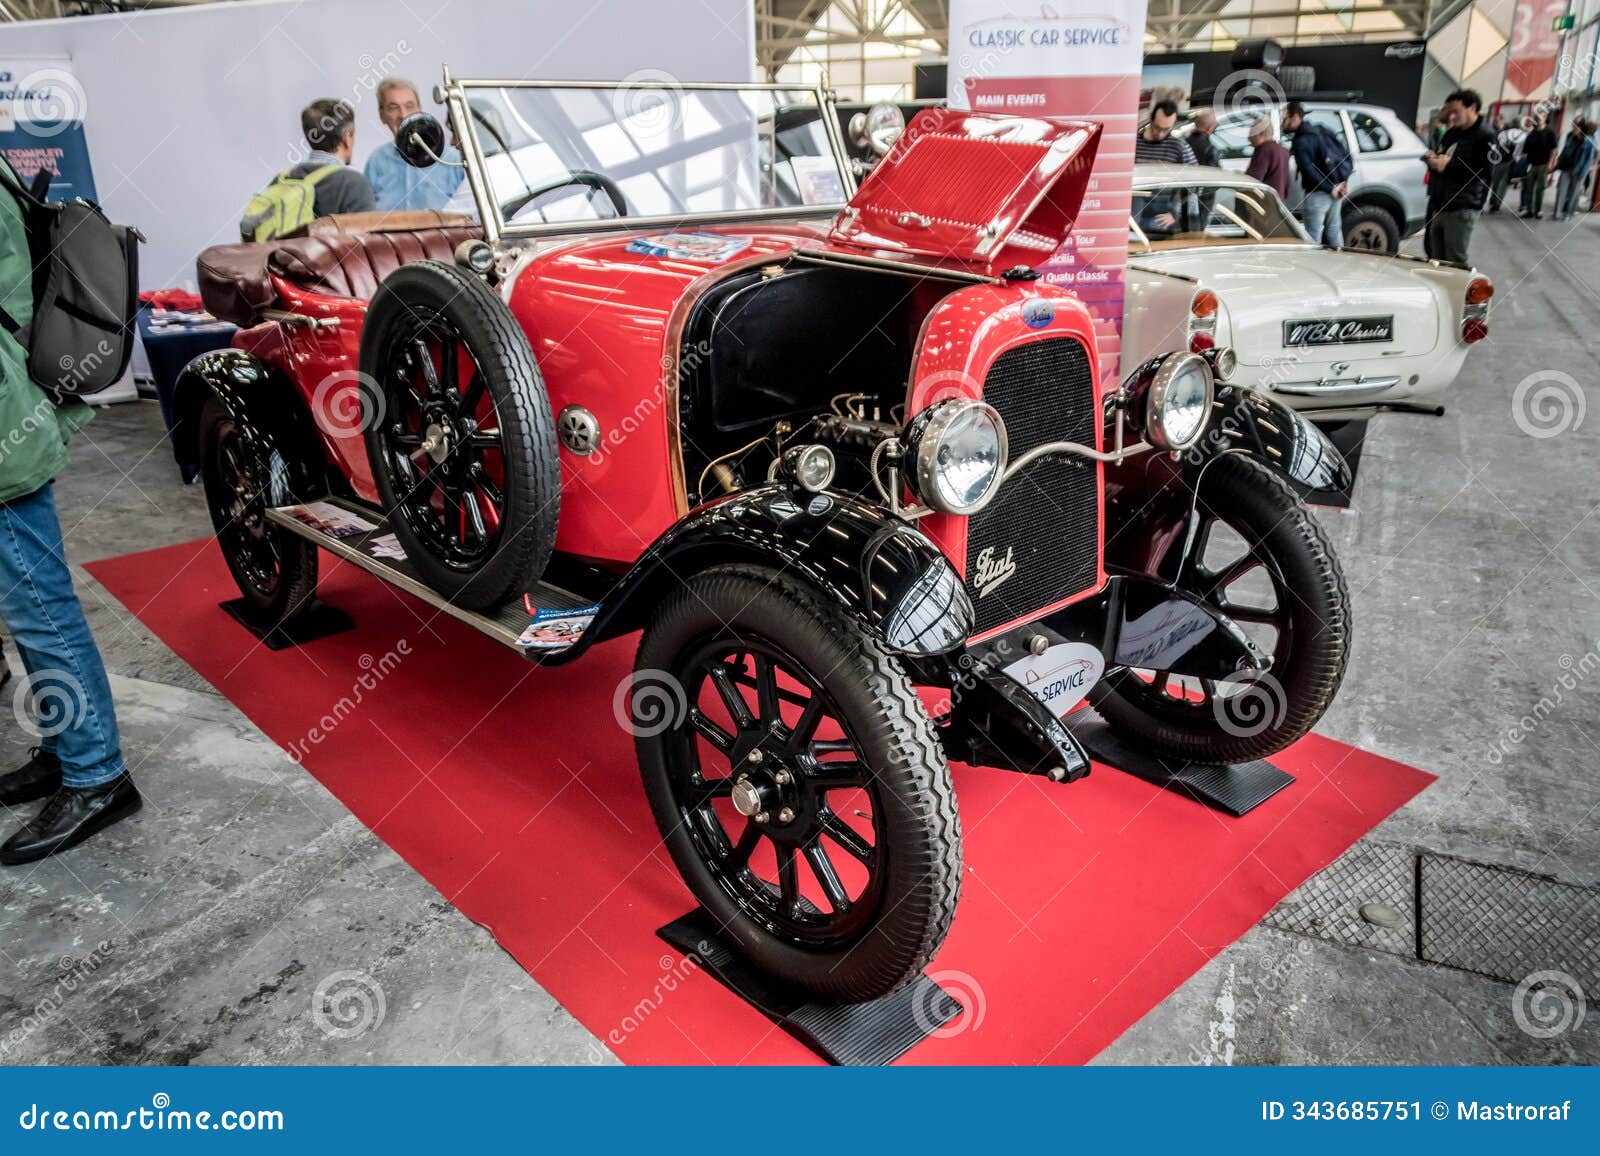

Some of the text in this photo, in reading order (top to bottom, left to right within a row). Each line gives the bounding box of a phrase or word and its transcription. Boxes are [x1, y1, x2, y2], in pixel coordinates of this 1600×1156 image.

[968, 27, 1120, 47] CLASSIC CAR SERVICE
[975, 93, 1047, 106] MAIN EVENTS
[1074, 235, 1097, 246] Tour
[1076, 270, 1110, 281] Classic
[973, 546, 1016, 599] Fiat
[1041, 669, 1085, 703] SERVICE
